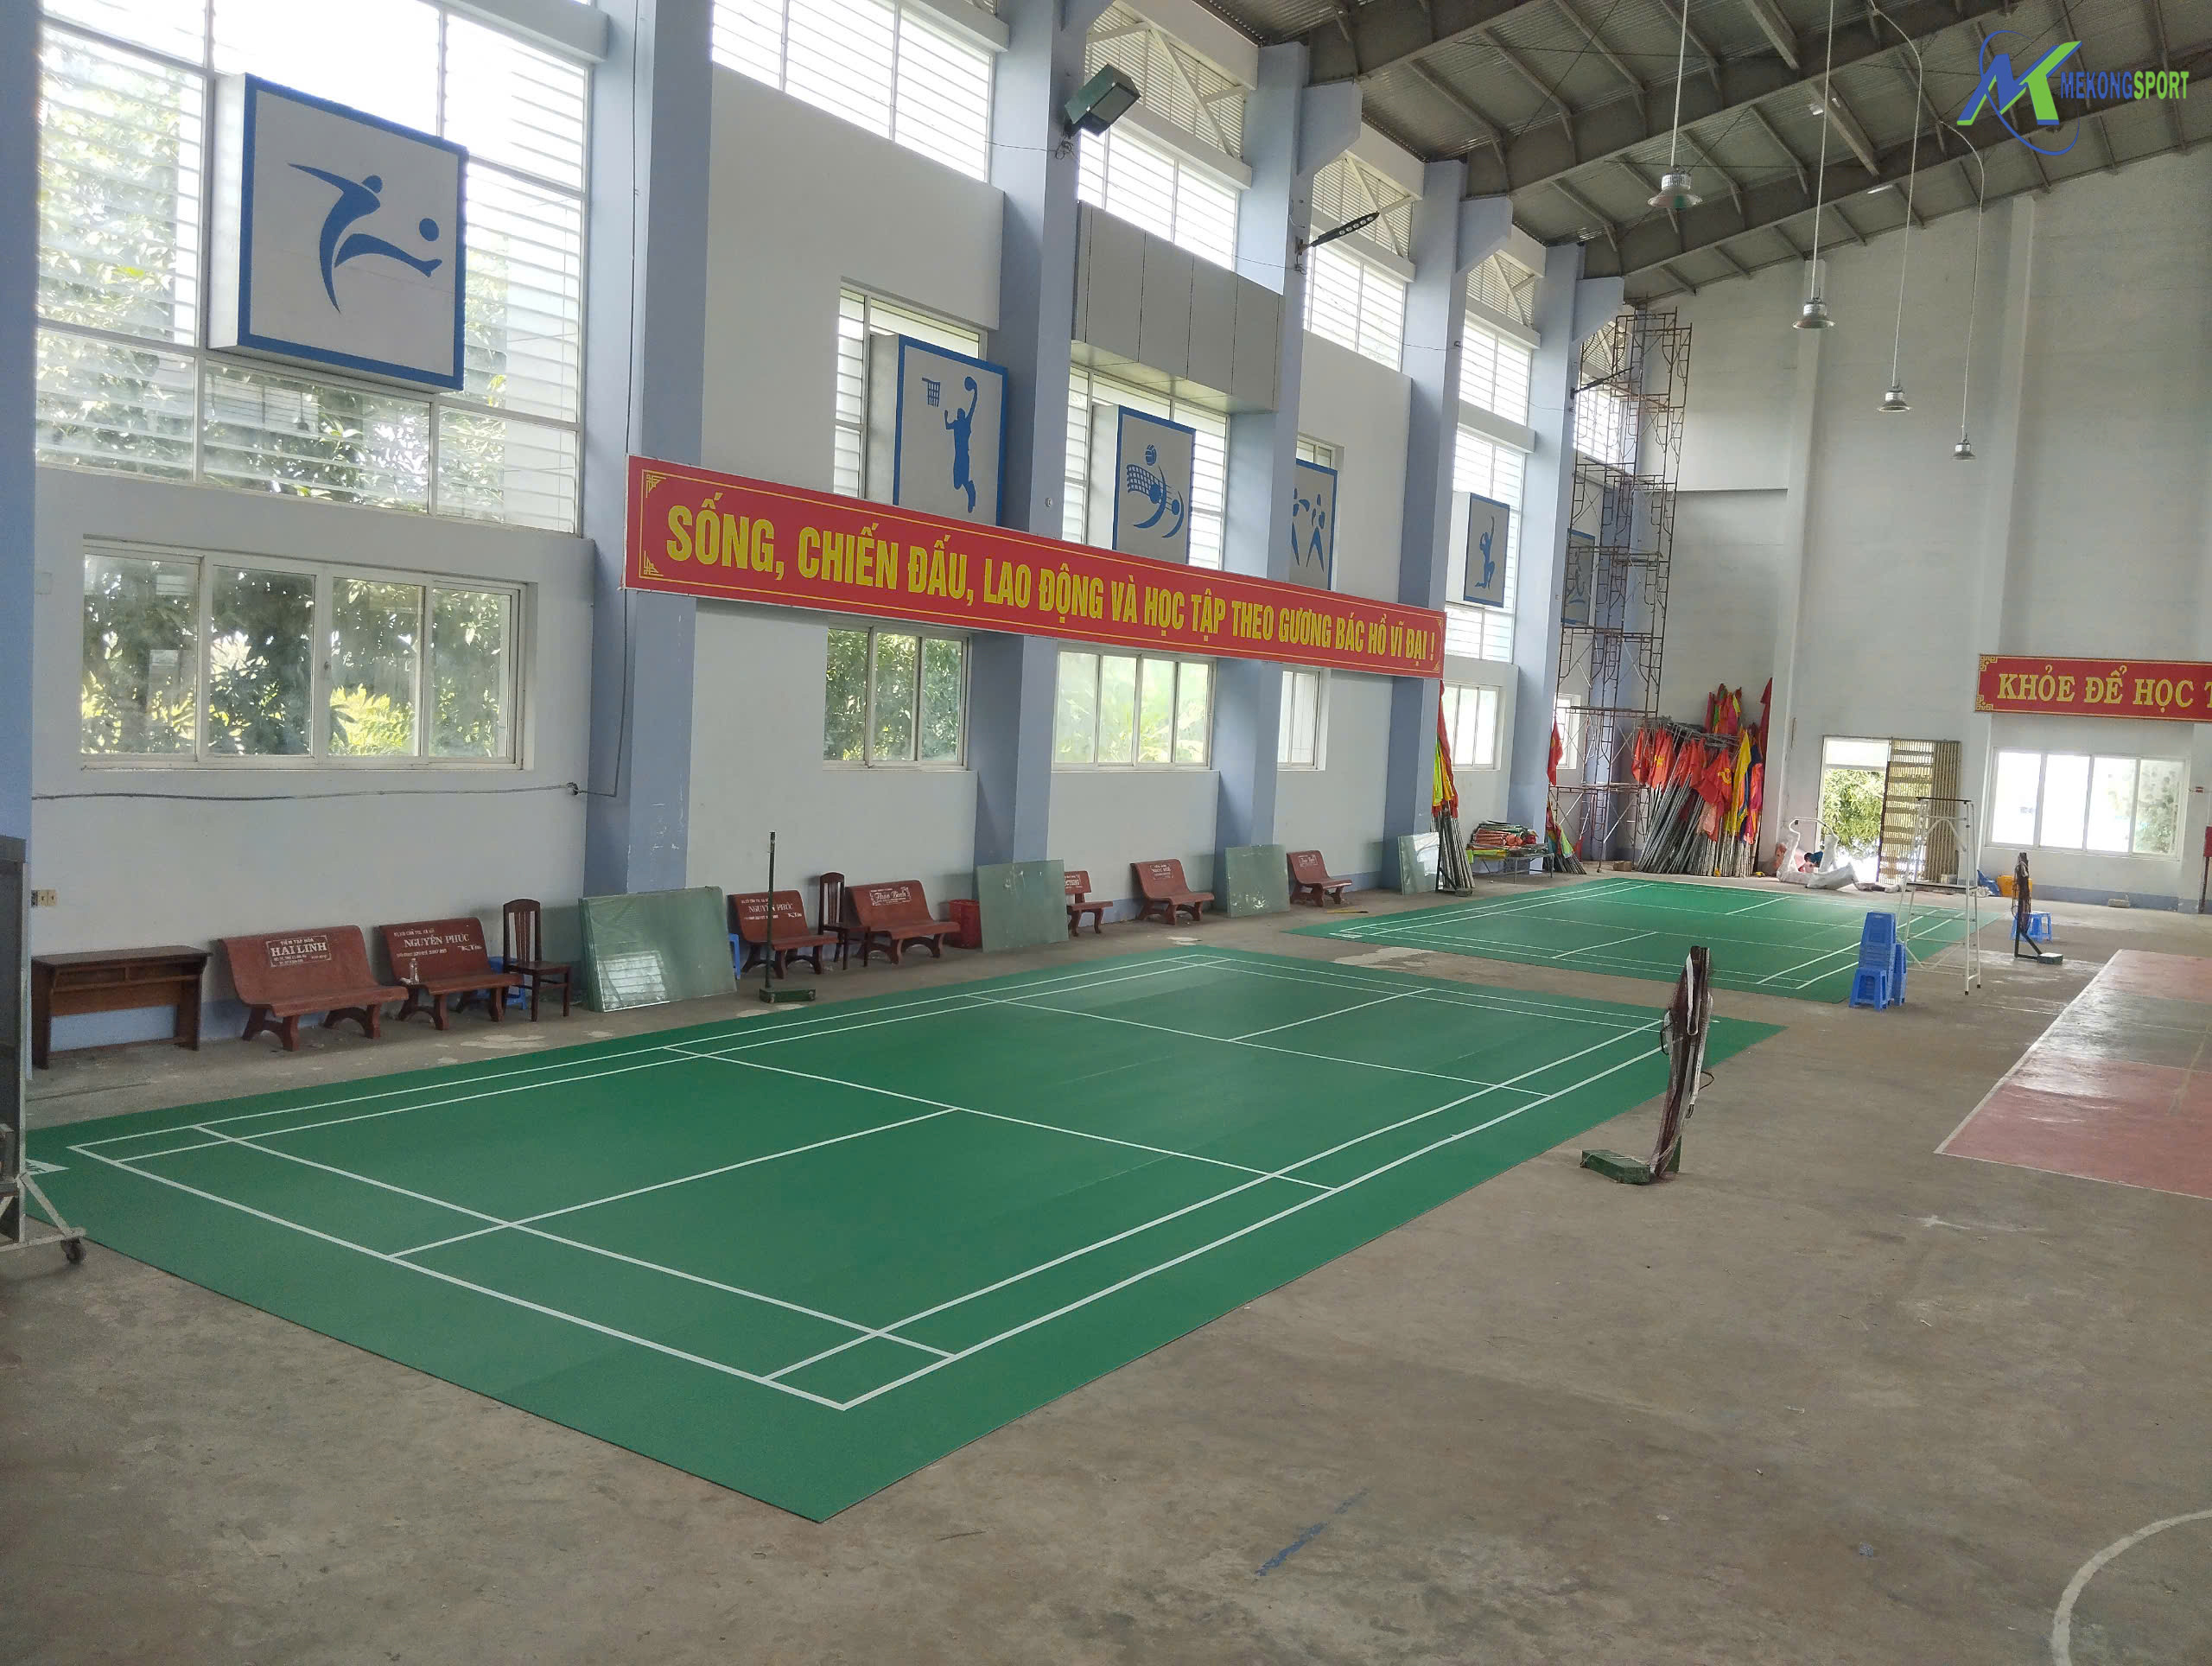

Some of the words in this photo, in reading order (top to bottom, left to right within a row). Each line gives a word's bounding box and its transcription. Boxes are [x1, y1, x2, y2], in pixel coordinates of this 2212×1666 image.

[666, 492, 785, 581] SỐNG,
[798, 522, 899, 590] CHIẾN
[907, 534, 974, 606] ĐẤU,
[983, 558, 1031, 609] LAO
[1038, 563, 1103, 625] ĐỘNG
[1110, 574, 1138, 624] VÀ
[1143, 586, 1185, 637] HỌC
[1190, 588, 1226, 642] TẬP
[1231, 601, 1274, 641] THEO
[1278, 607, 1332, 649] GƯƠNG
[1335, 612, 1365, 653] BÁC
[1367, 614, 1388, 656] HỒ
[1389, 620, 1405, 658] VĨ
[1405, 628, 1428, 666] ĐẠI
[1430, 632, 1435, 661] !
[1997, 664, 2075, 703] KHỎE
[2083, 664, 2128, 705] ĐỂ
[2133, 677, 2195, 714] HỌC
[296, 942, 327, 954] LINH
